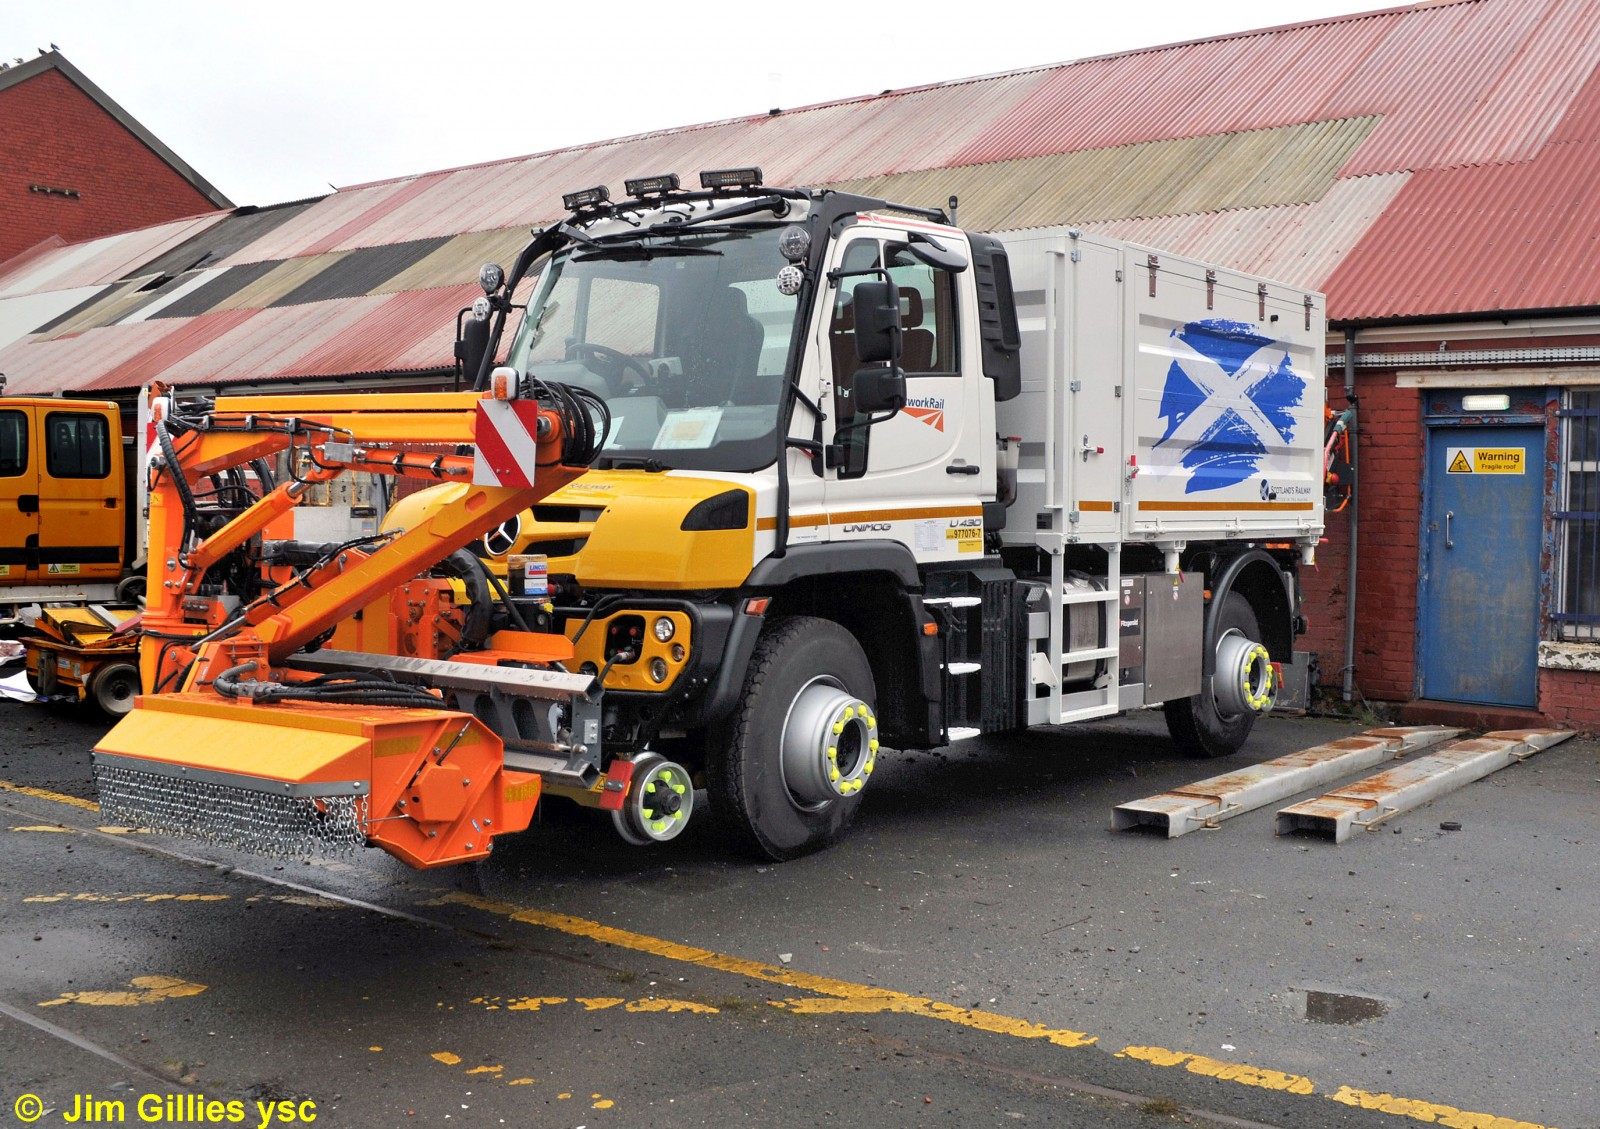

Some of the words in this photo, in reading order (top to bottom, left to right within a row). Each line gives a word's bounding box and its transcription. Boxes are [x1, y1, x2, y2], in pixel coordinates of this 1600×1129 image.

[906, 397, 944, 409] workRail
[1478, 452, 1520, 463] Warning
[1481, 463, 1502, 471] Fragile
[843, 522, 892, 533] UNIMOG
[959, 518, 982, 527] 430
[953, 528, 982, 539] 977076-7
